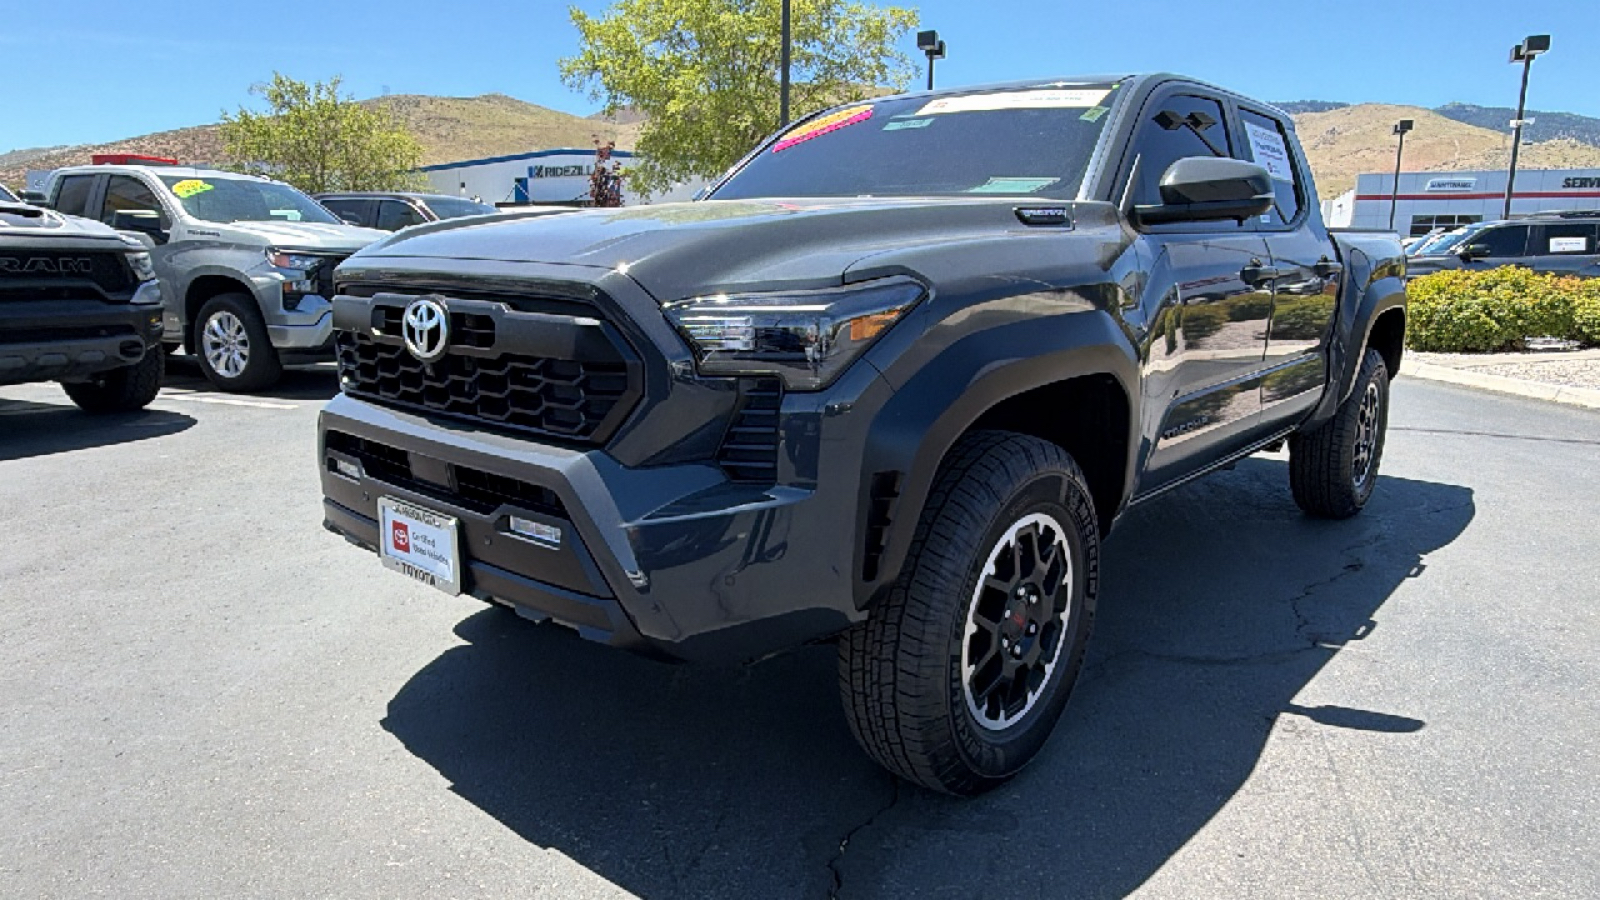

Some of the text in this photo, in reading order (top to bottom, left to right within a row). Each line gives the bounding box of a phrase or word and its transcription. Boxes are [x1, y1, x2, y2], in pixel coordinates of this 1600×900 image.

[544, 165, 595, 177] RIDEZILL
[0, 257, 92, 272] RAM
[412, 532, 435, 548] Certified
[1077, 501, 1098, 595] MICHELIN
[402, 562, 436, 586] TOYOTA
